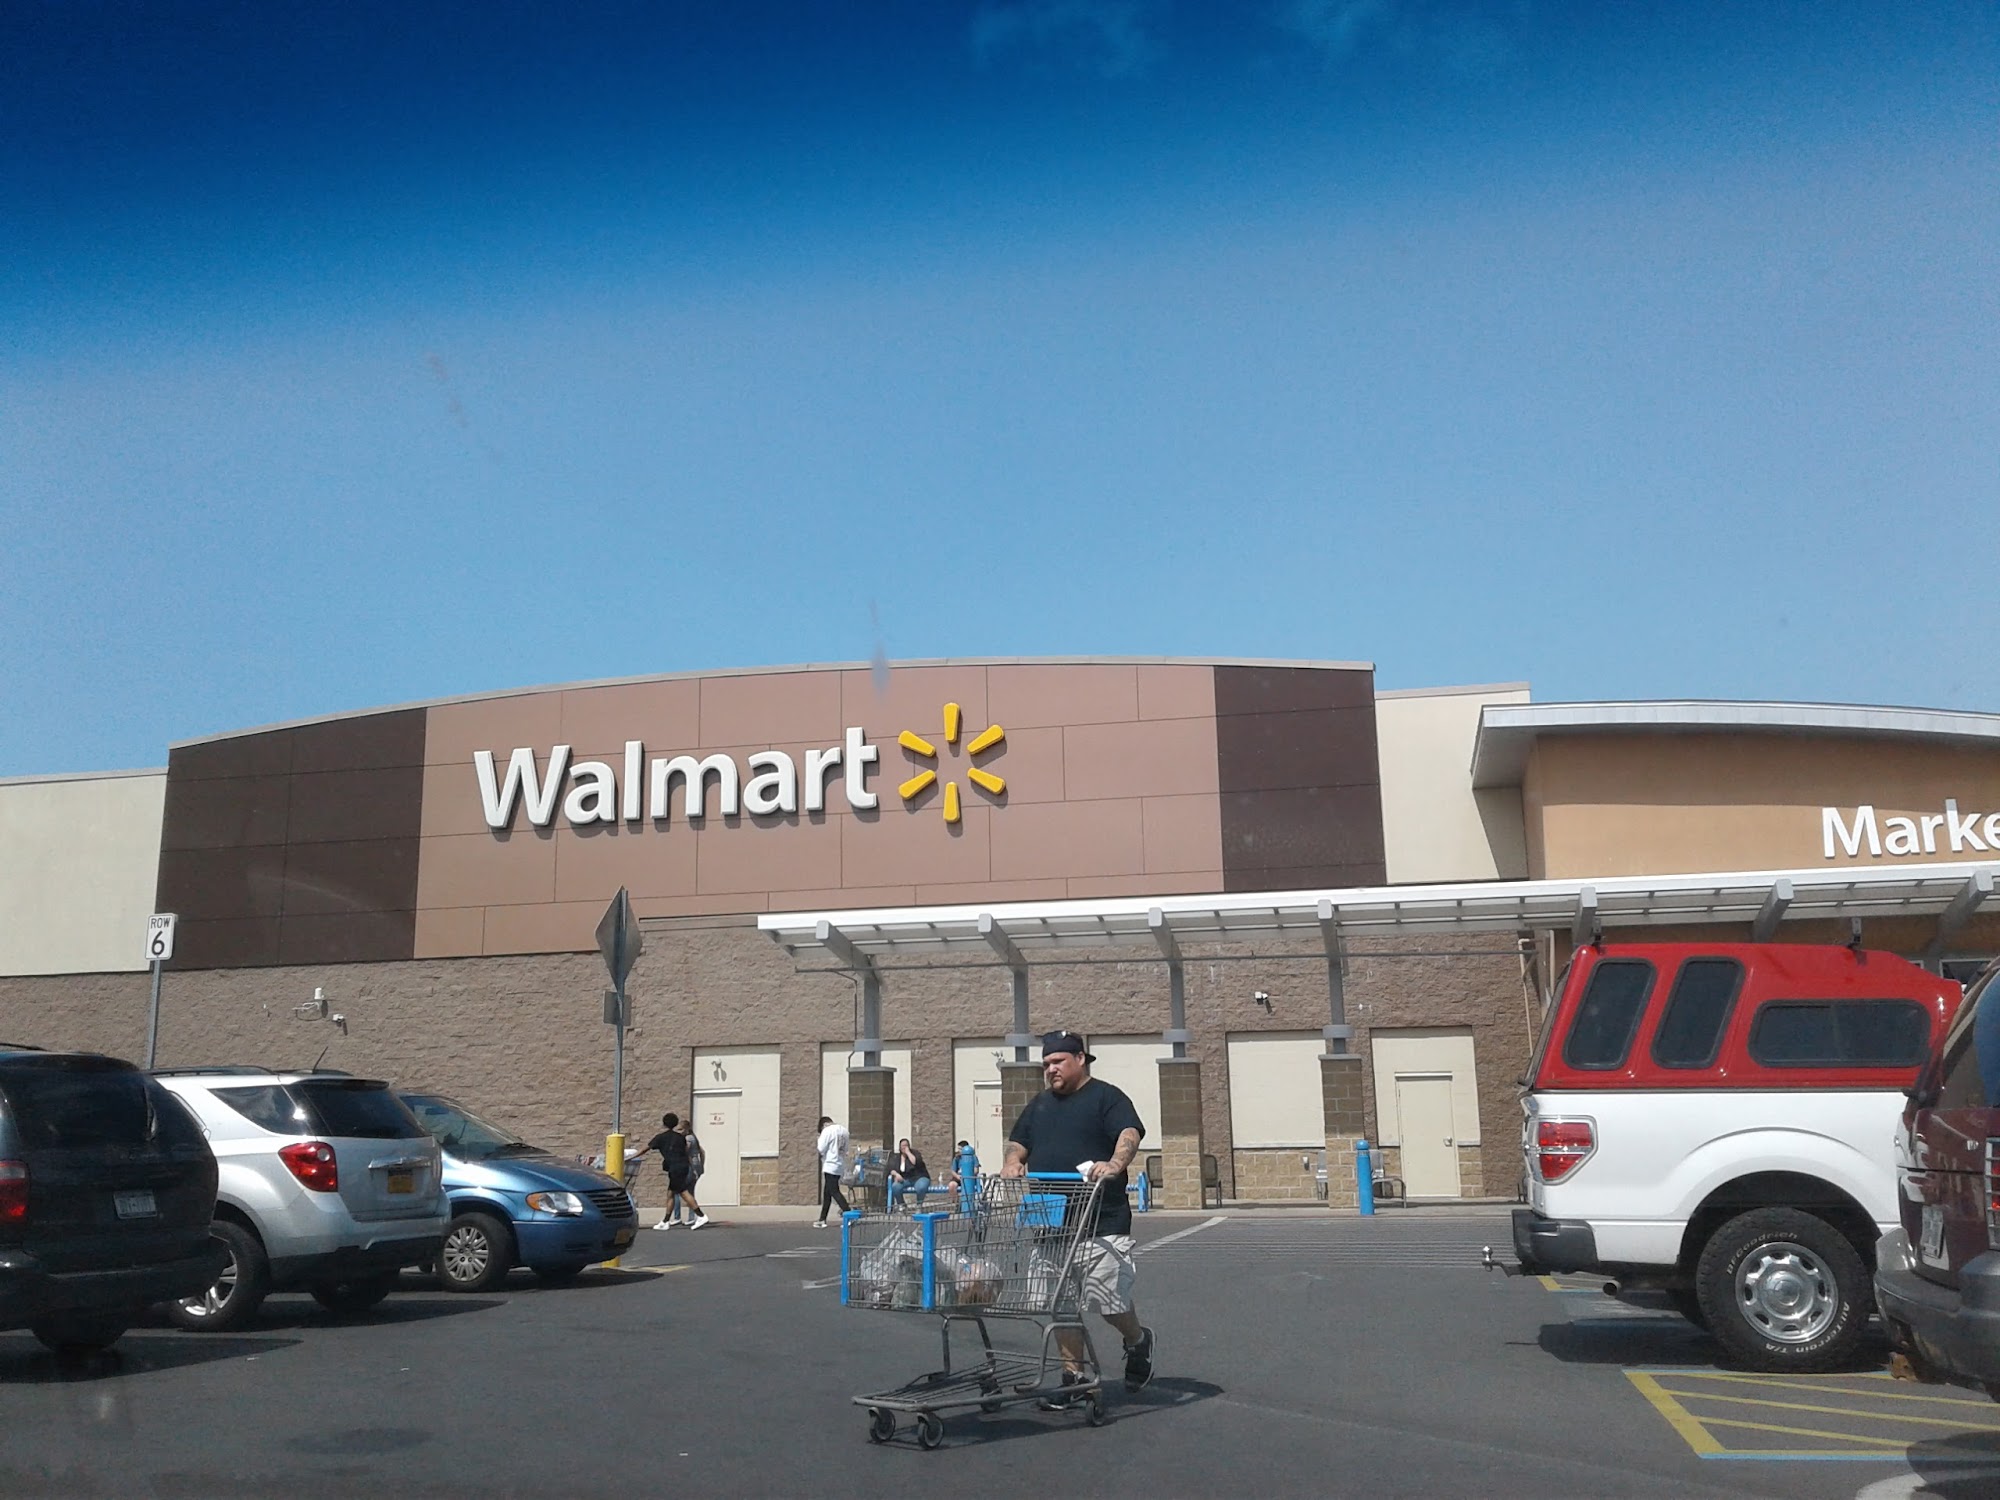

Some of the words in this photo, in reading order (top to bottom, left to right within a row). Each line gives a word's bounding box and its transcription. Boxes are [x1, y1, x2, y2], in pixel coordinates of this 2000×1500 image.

[474, 727, 878, 828] Walmart
[151, 917, 171, 929] ROW
[151, 930, 165, 956] 6
[1726, 1231, 1798, 1275] BFGoodrich
